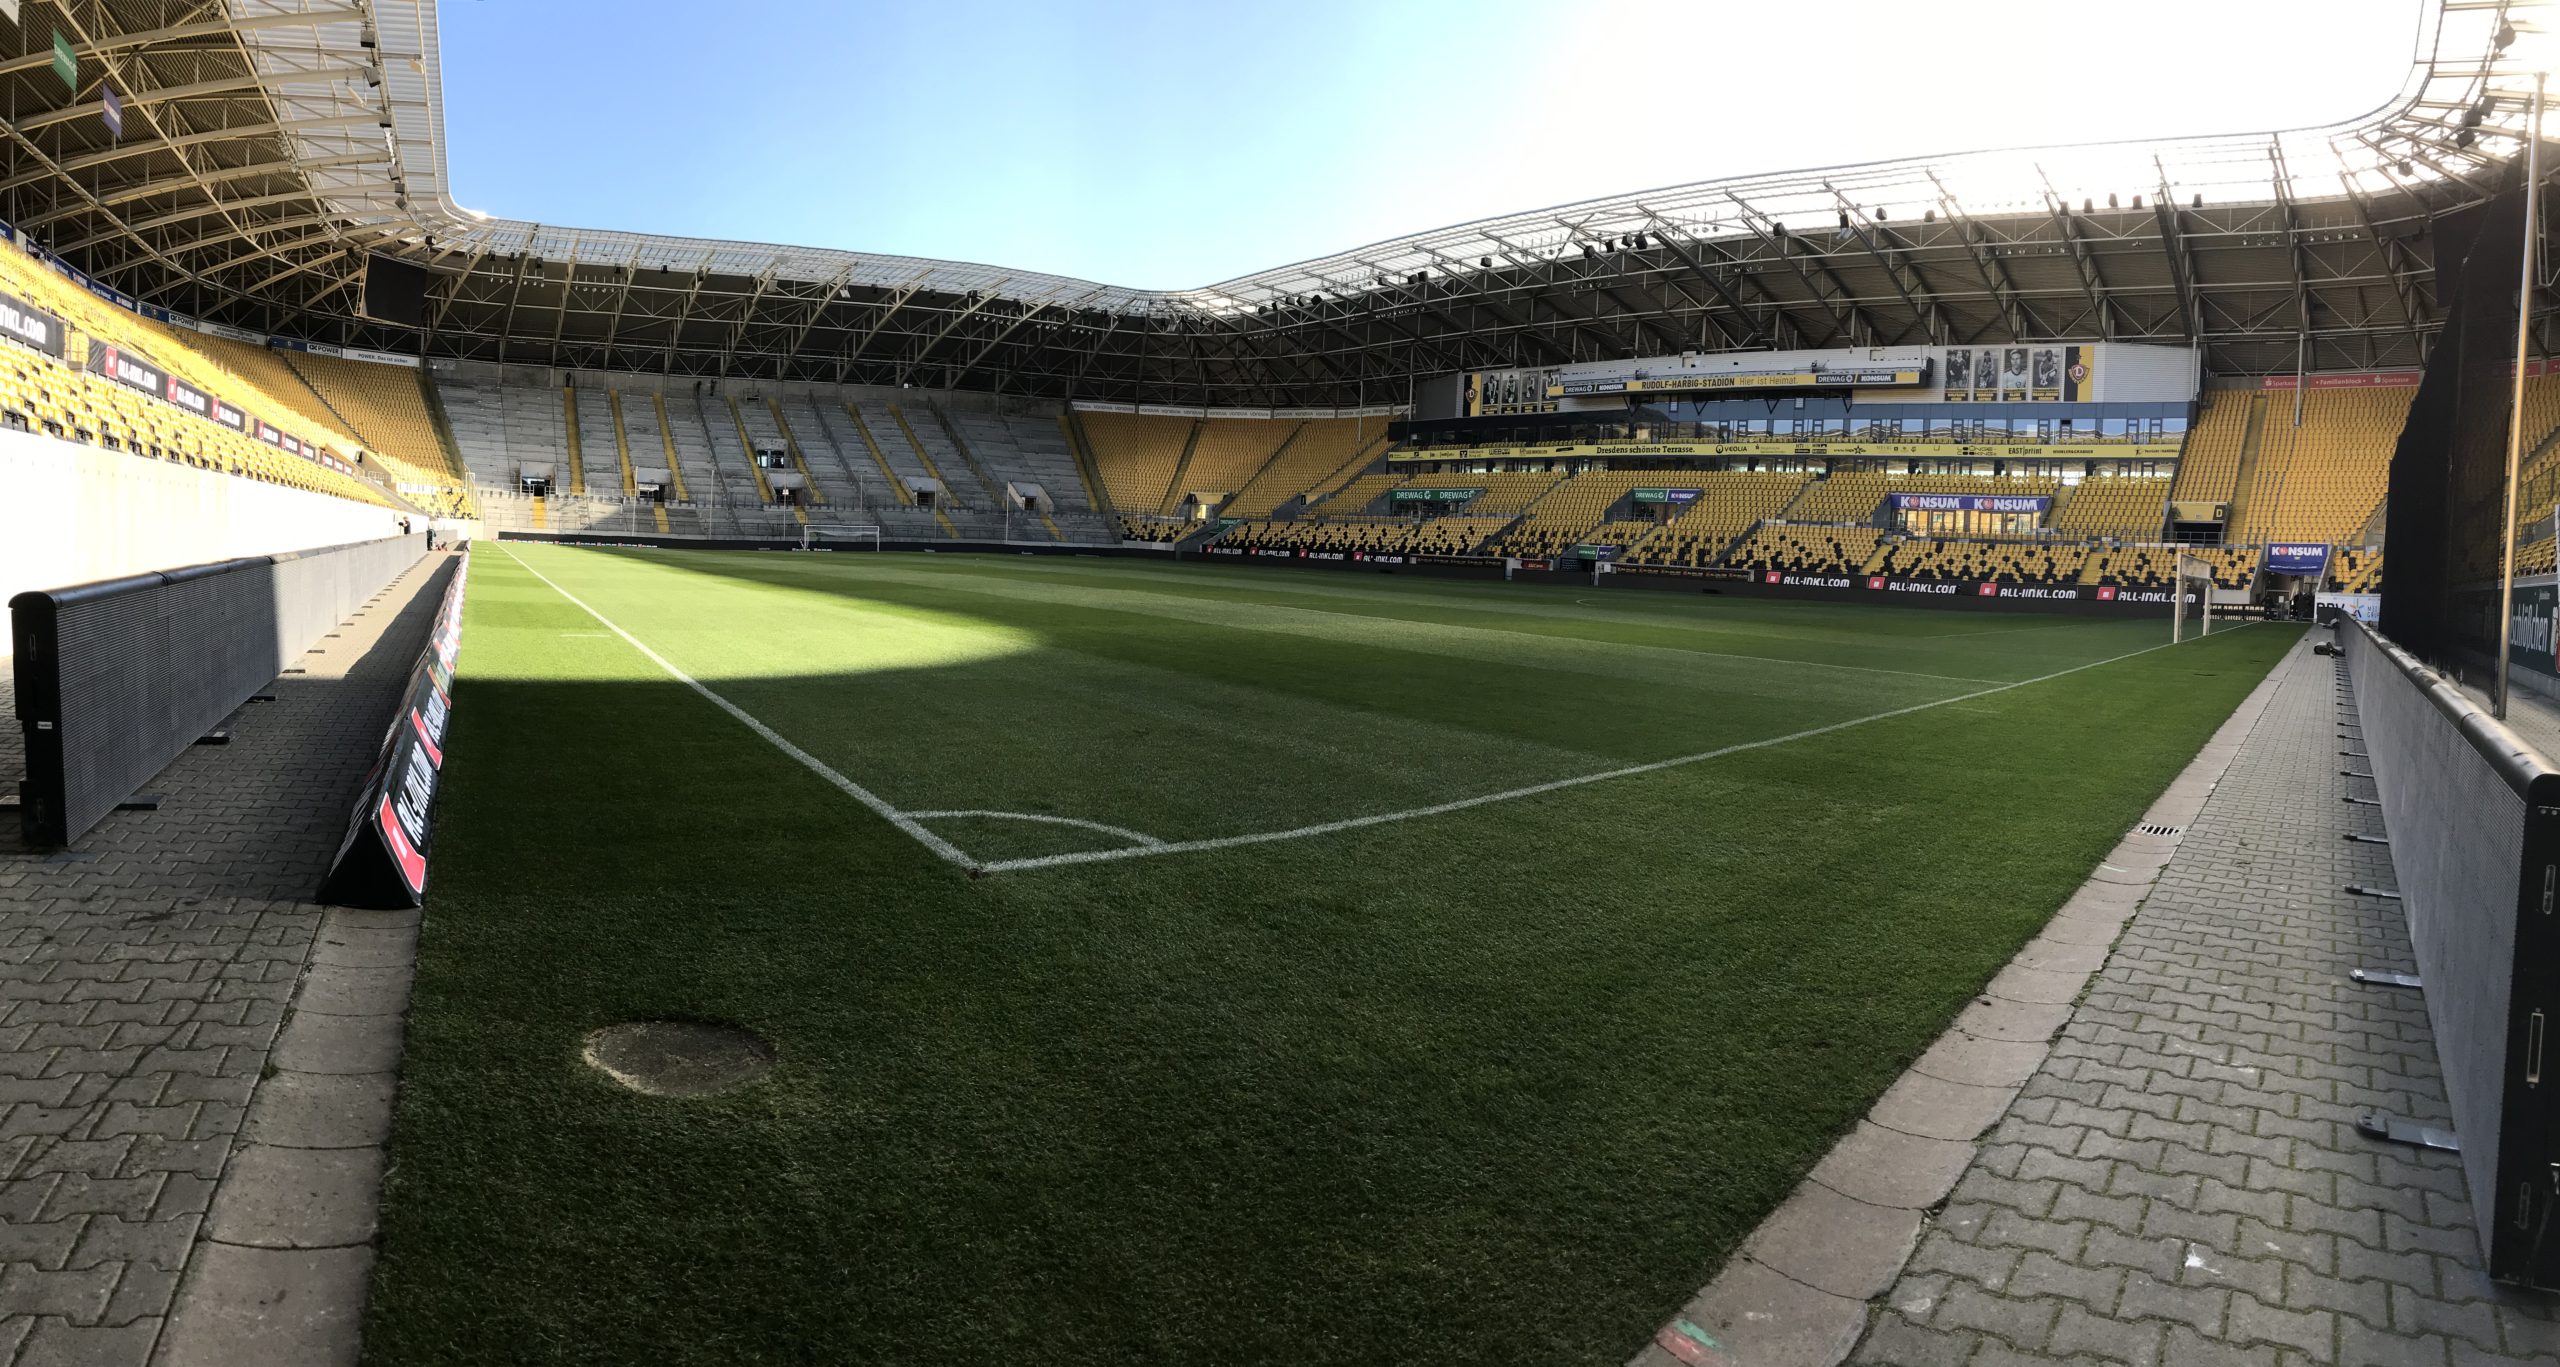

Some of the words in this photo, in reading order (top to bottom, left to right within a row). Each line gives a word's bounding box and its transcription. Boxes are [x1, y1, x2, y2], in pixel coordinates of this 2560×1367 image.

[1641, 378, 1735, 389] RUDOLF-HARBIG-STADION
[1739, 376, 1755, 385] Hier
[1597, 446, 1628, 454] Dresdens
[1629, 445, 1661, 453] schönste
[1662, 445, 1695, 453] Terrasse.
[1396, 491, 1423, 499] DREWAG
[1440, 491, 1468, 499] DREWAG
[1900, 496, 1960, 508] KONSUM
[1974, 498, 2038, 511] KONSUM
[2215, 508, 2223, 518] D
[1308, 551, 1344, 561] ALL-INKL.COM
[2271, 546, 2323, 556] KONSUM
[1783, 576, 1850, 588] ALL-INKL.COM
[2117, 591, 2197, 604] ALL-INKL.CM
[397, 741, 432, 847] ALL-INKL.COM
